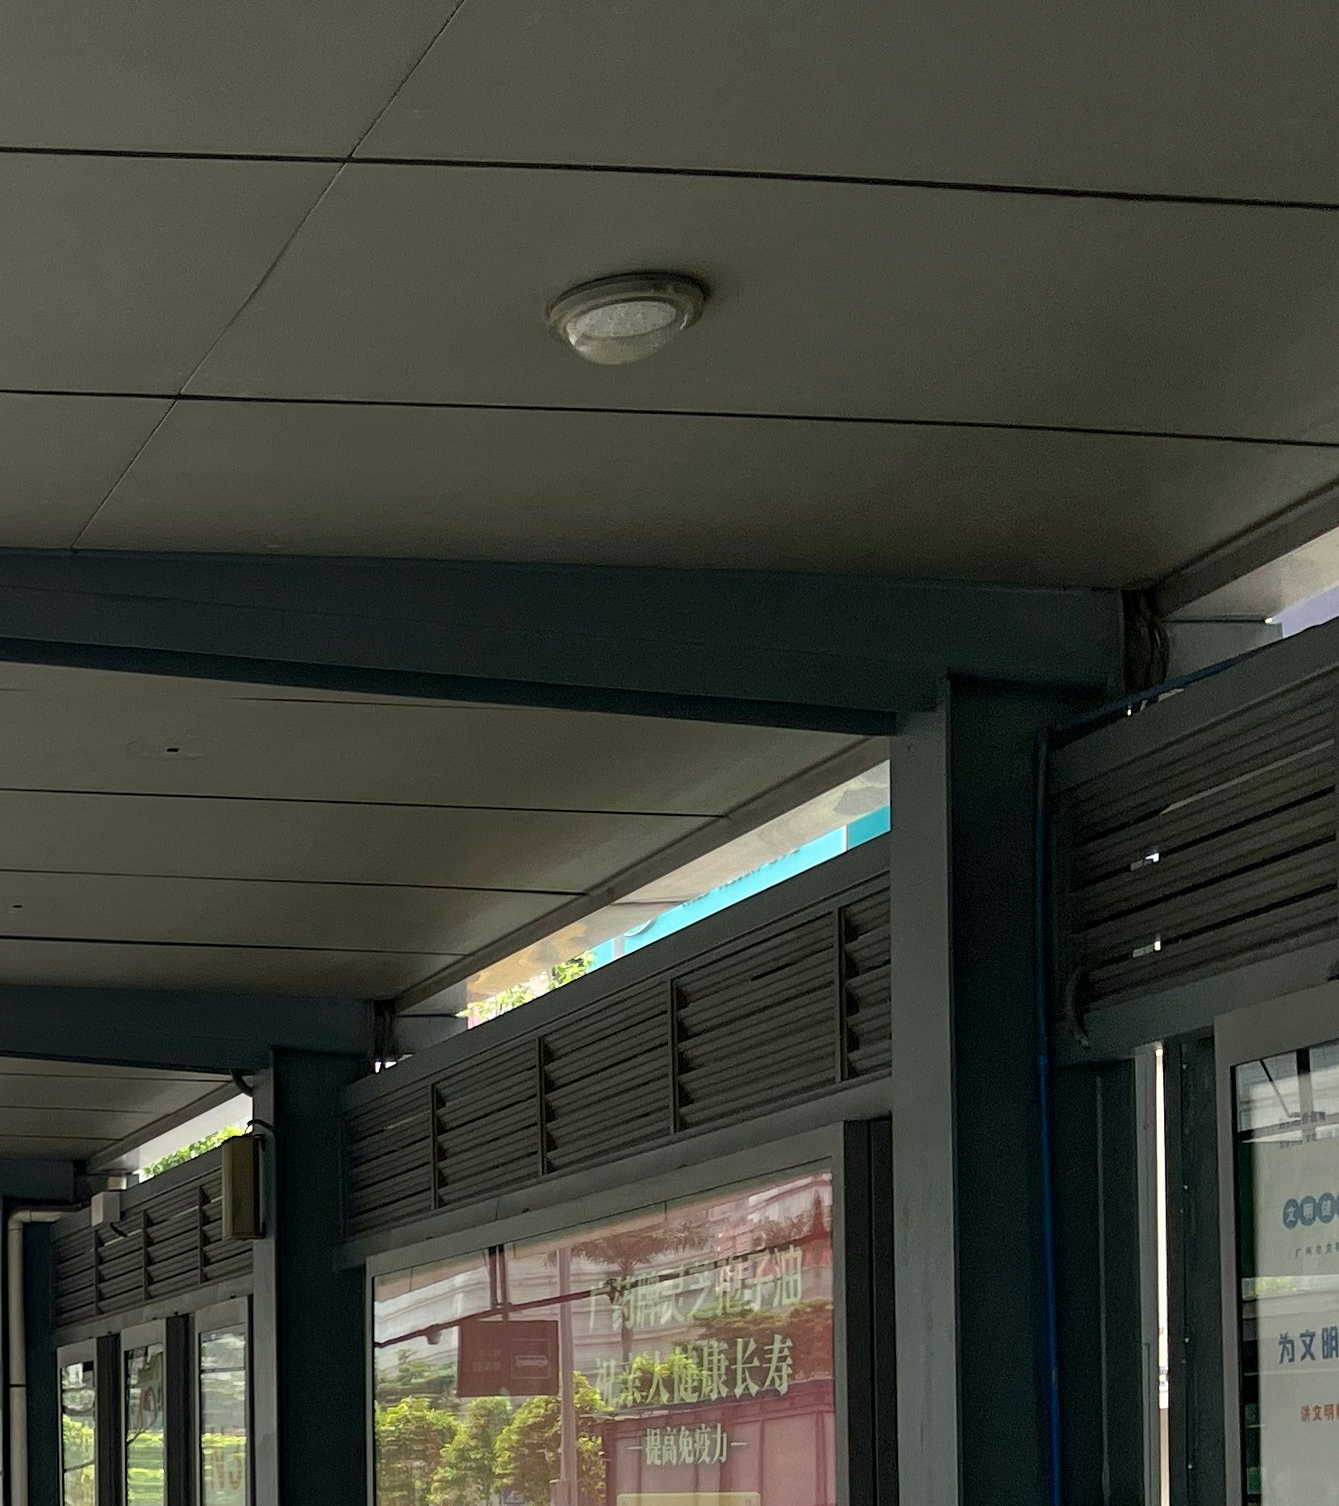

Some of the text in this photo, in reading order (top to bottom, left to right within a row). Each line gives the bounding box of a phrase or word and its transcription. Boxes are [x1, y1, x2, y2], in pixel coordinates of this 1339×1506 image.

[645, 1423, 728, 1465] 提高免疫力
